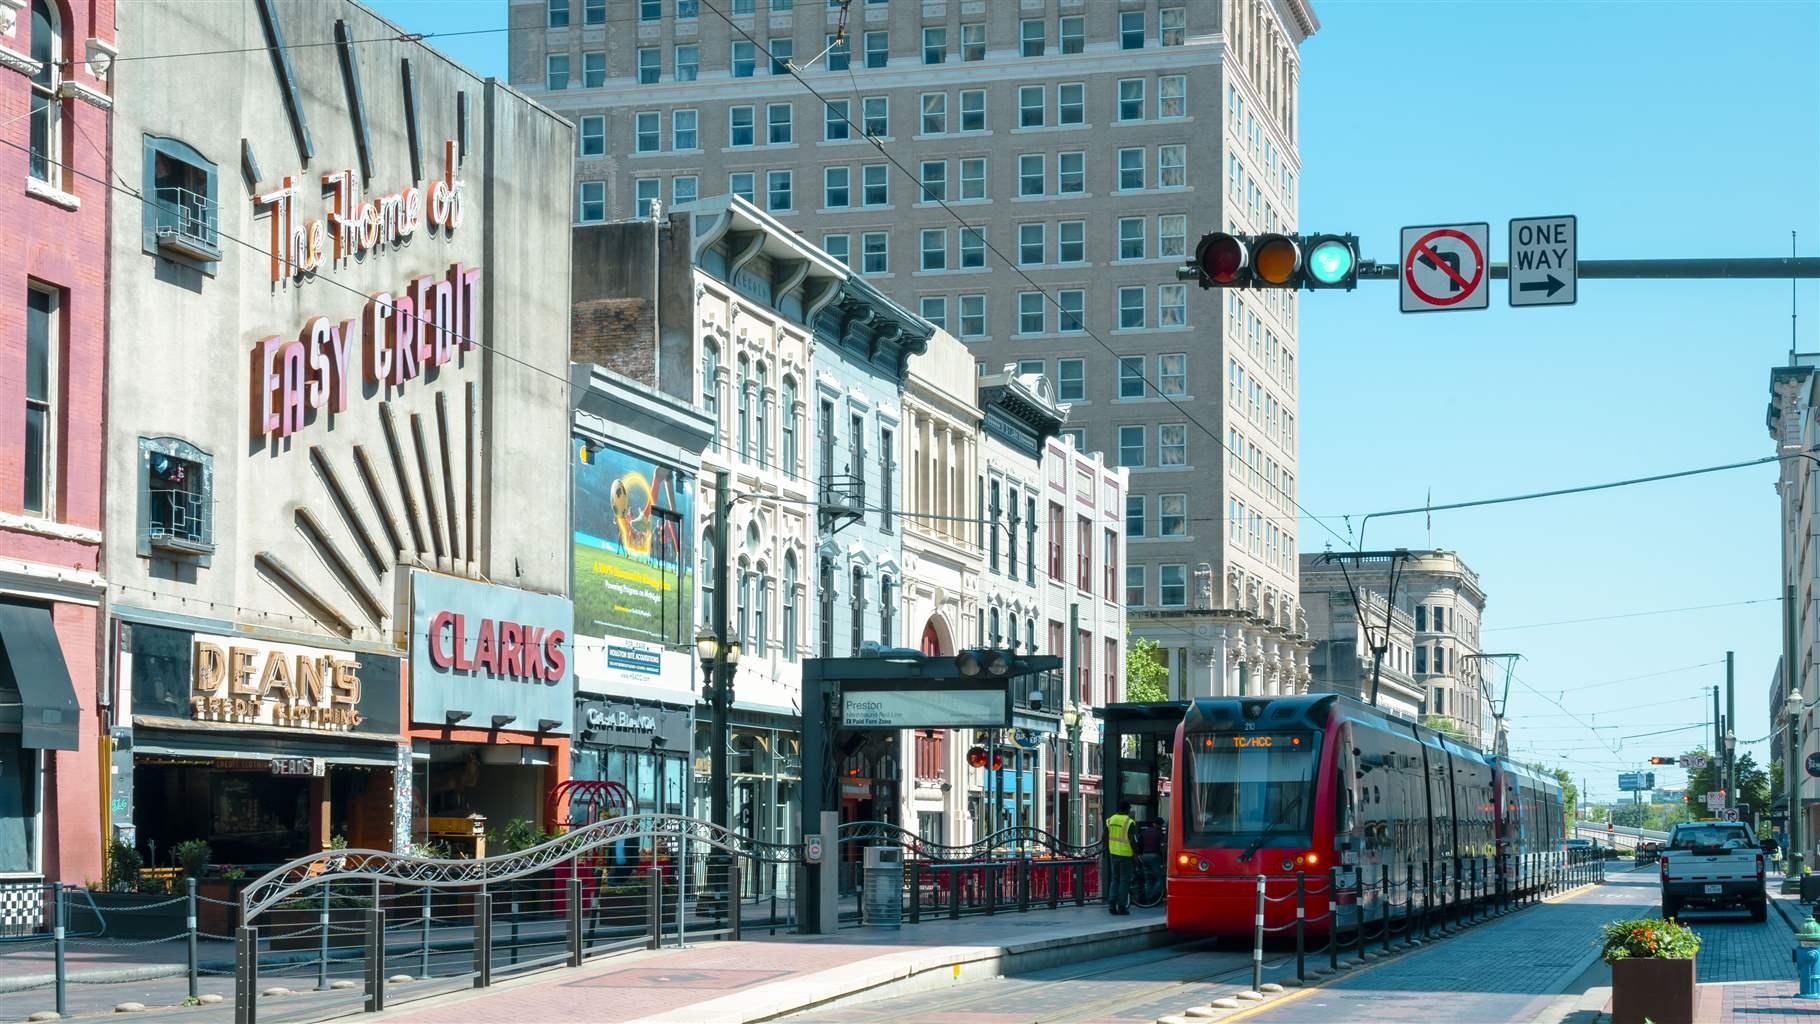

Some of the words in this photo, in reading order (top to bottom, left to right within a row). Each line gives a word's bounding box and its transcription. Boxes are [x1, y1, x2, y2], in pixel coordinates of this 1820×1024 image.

[254, 175, 326, 281] The
[322, 168, 420, 260] Home
[427, 140, 464, 228] of
[1518, 223, 1568, 246] ONE
[1517, 248, 1568, 271] WAY
[250, 315, 355, 437] EASY
[363, 263, 480, 386] CREDIT
[429, 611, 566, 682] CLARKS
[193, 641, 363, 704] DEAN'S
[192, 696, 262, 717] CREDIT
[273, 703, 364, 725] CLOTHING
[846, 700, 882, 710] Preston
[1232, 736, 1272, 748] TC/HCC
